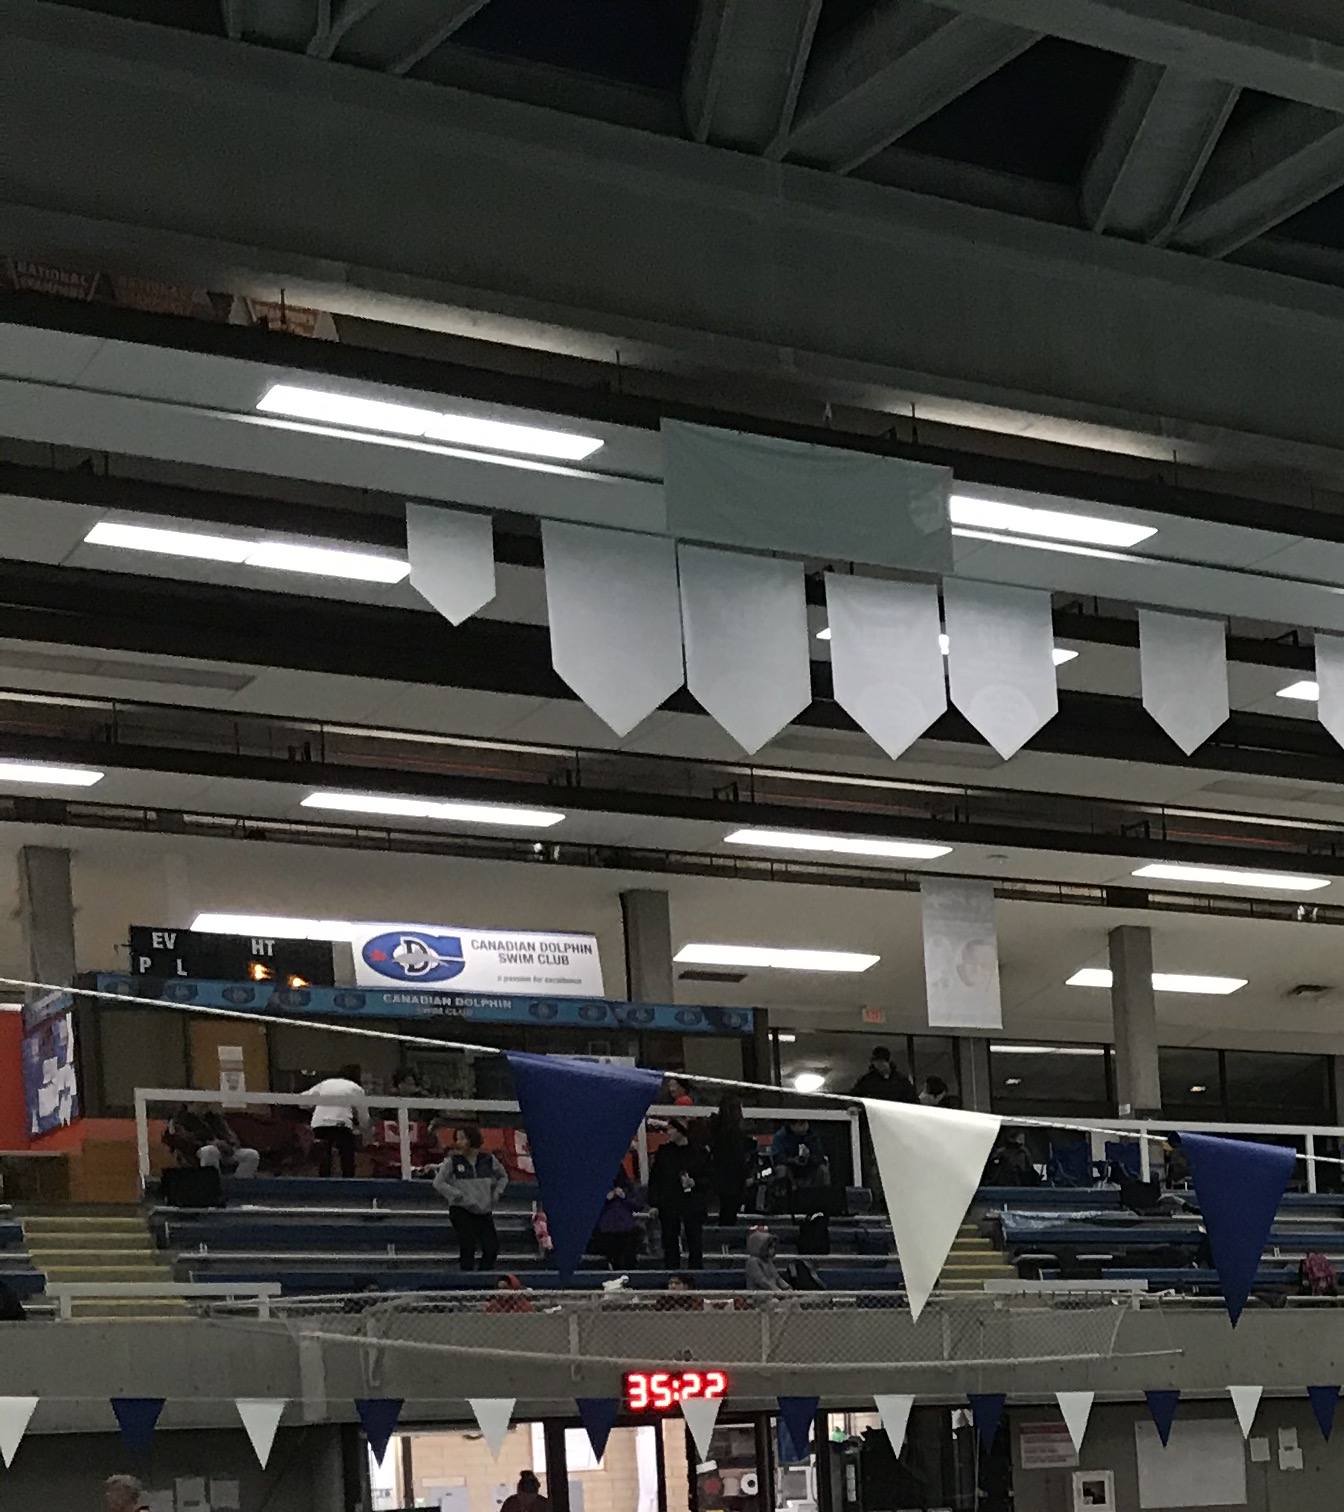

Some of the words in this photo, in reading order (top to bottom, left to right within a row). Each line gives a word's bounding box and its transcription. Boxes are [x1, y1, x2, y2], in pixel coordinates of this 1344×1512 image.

[152, 932, 177, 949] EV
[252, 939, 275, 956] HT
[471, 939, 537, 953] CANADIAN
[540, 941, 593, 955] DOLPHIN
[139, 957, 151, 974] P
[177, 959, 187, 976] L
[498, 953, 534, 965] SWIM
[537, 953, 570, 966] CLUB
[383, 993, 451, 1006] CANADIAN
[456, 998, 512, 1009] DOLPHIN
[627, 1372, 725, 1408] 35:22
